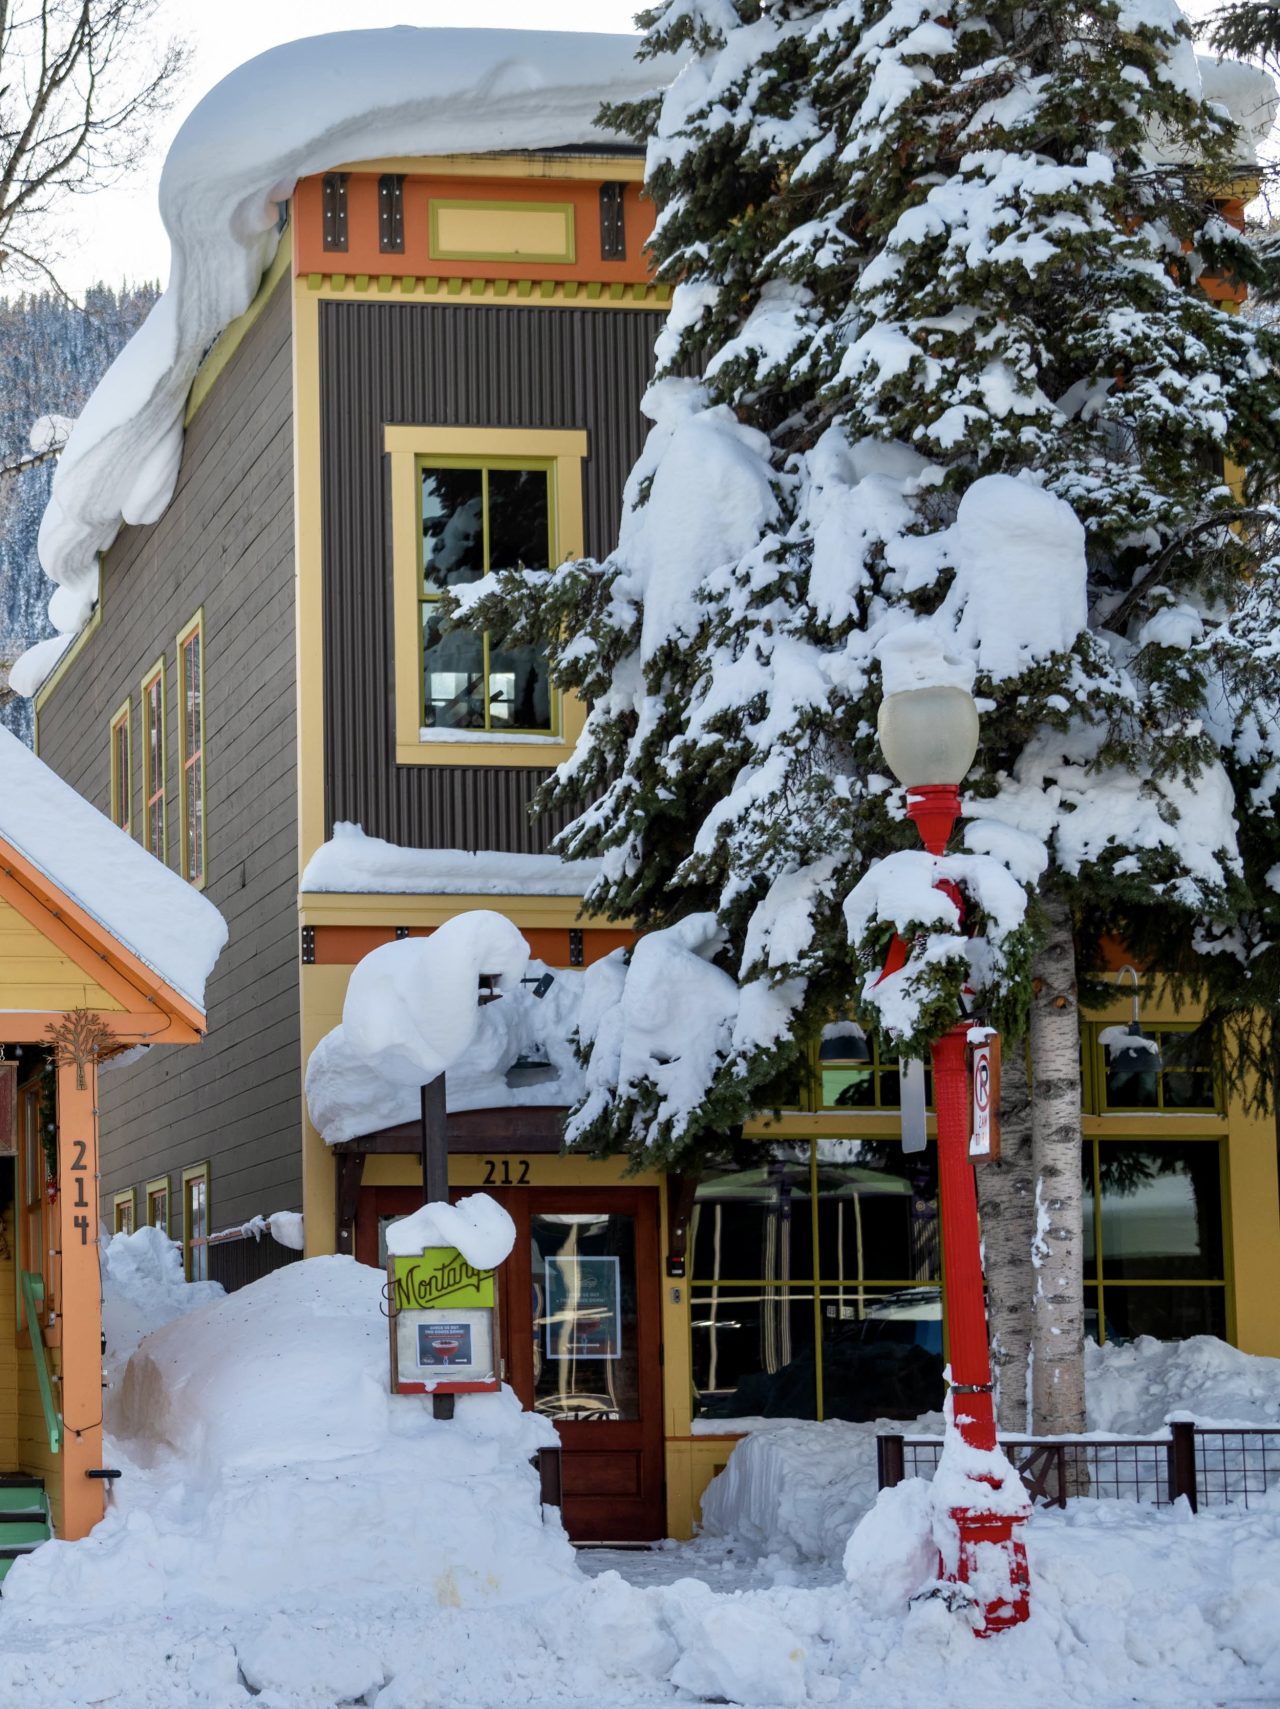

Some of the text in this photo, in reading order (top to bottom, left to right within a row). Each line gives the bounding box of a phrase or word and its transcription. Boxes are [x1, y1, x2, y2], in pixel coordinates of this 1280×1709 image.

[70, 1140, 90, 1246] 214
[482, 1160, 531, 1185] 212
[380, 1252, 494, 1318] Montany
